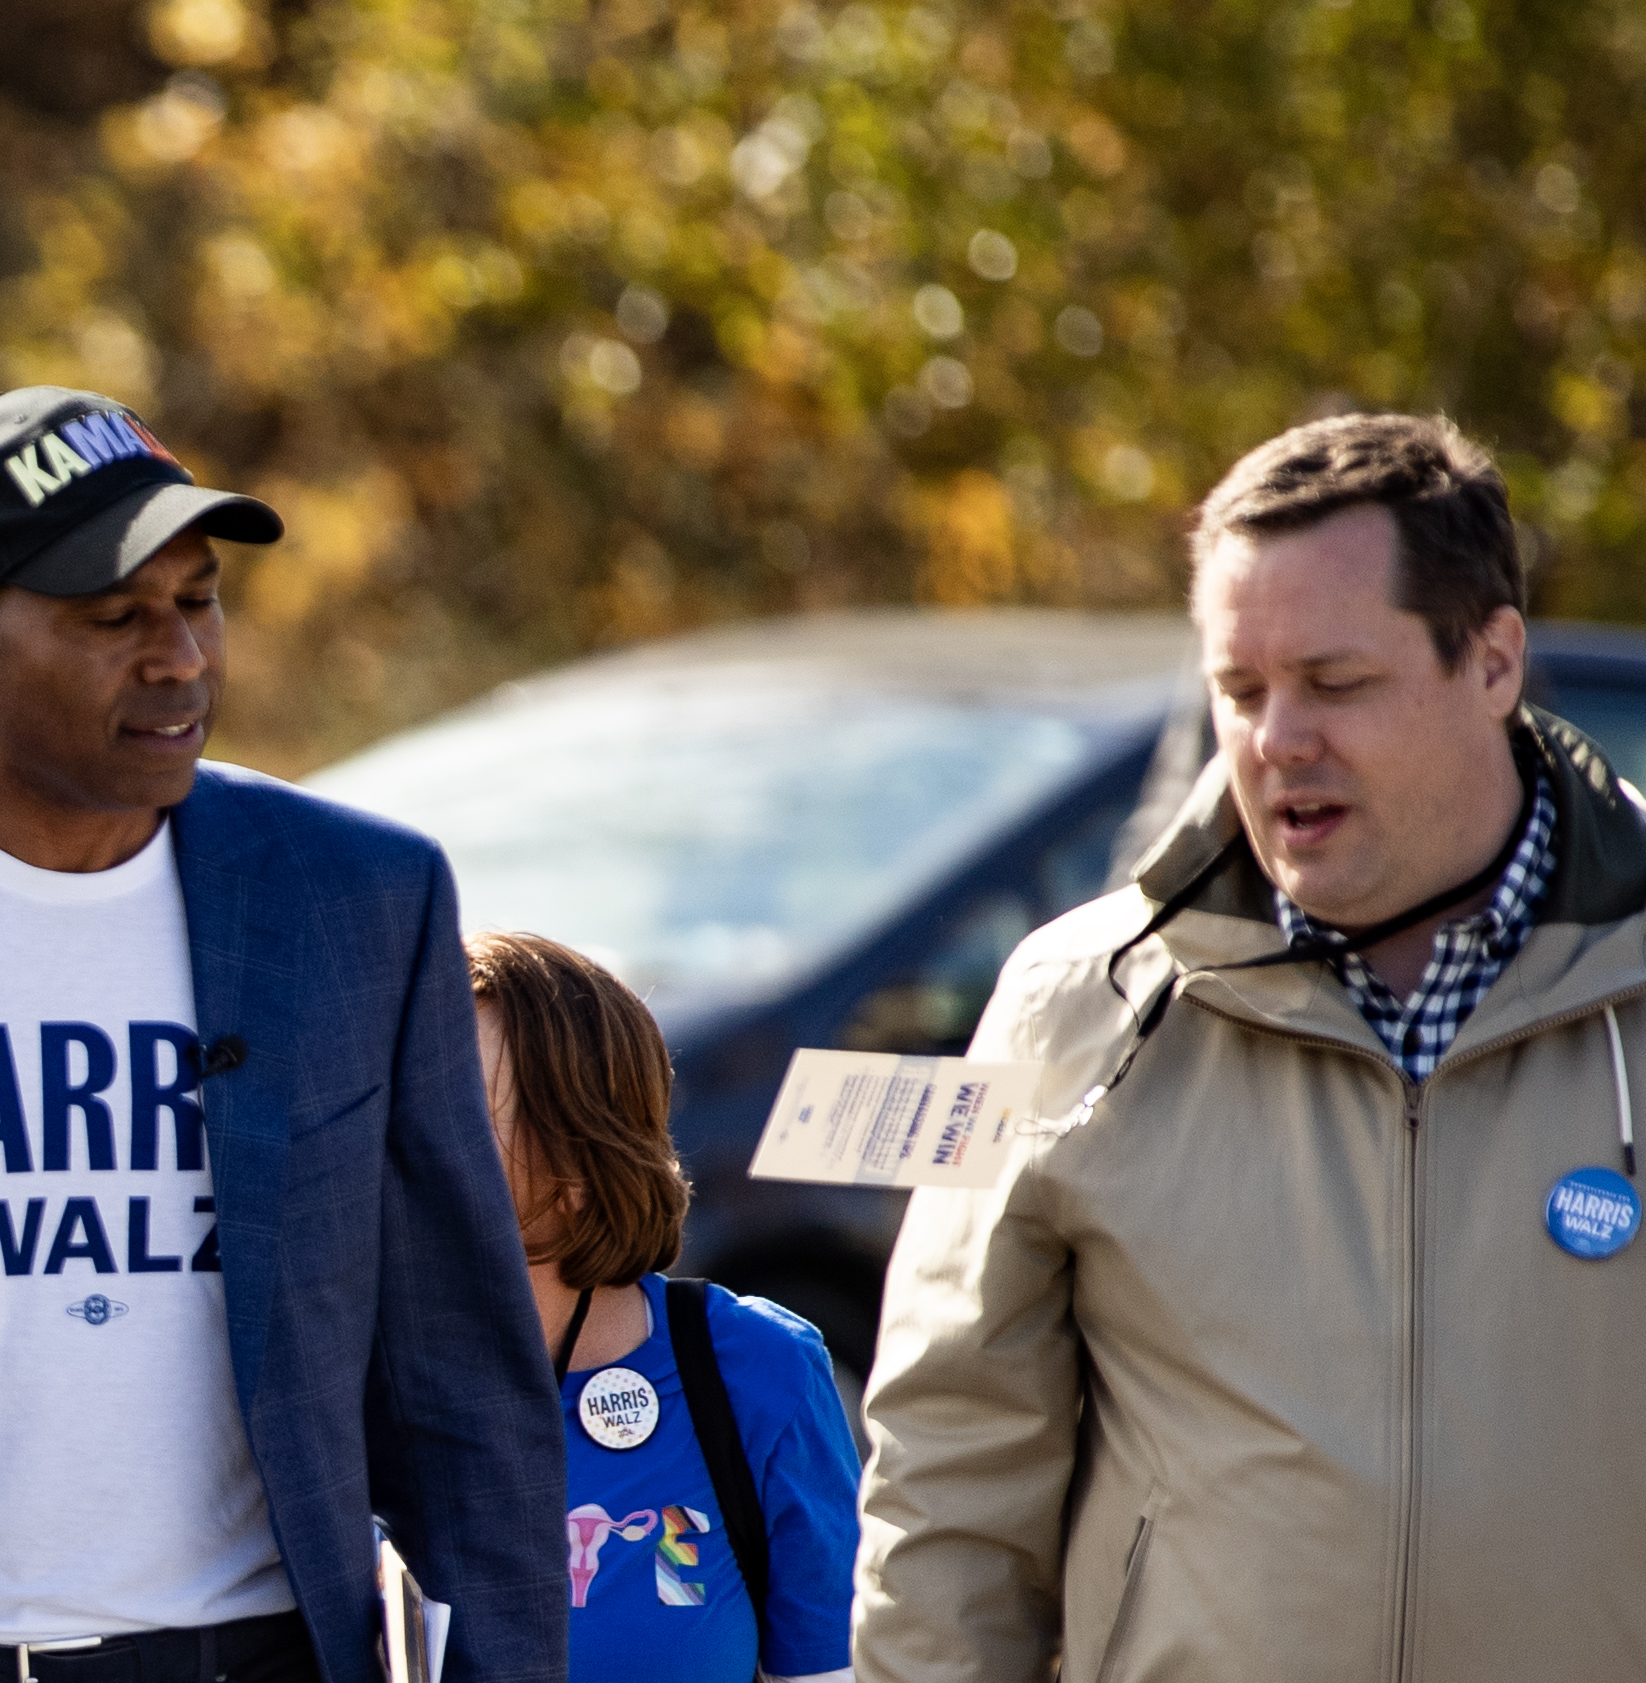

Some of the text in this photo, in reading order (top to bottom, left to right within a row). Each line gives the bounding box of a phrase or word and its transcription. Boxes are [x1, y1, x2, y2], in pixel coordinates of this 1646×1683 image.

[4, 408, 182, 508] KAMA
[932, 1082, 979, 1164] WE WIN
[1556, 1186, 1634, 1228] HARRIS
[1566, 1214, 1614, 1239] WALZ
[587, 1387, 649, 1416] HARRIS
[603, 1411, 643, 1428] WALZ
